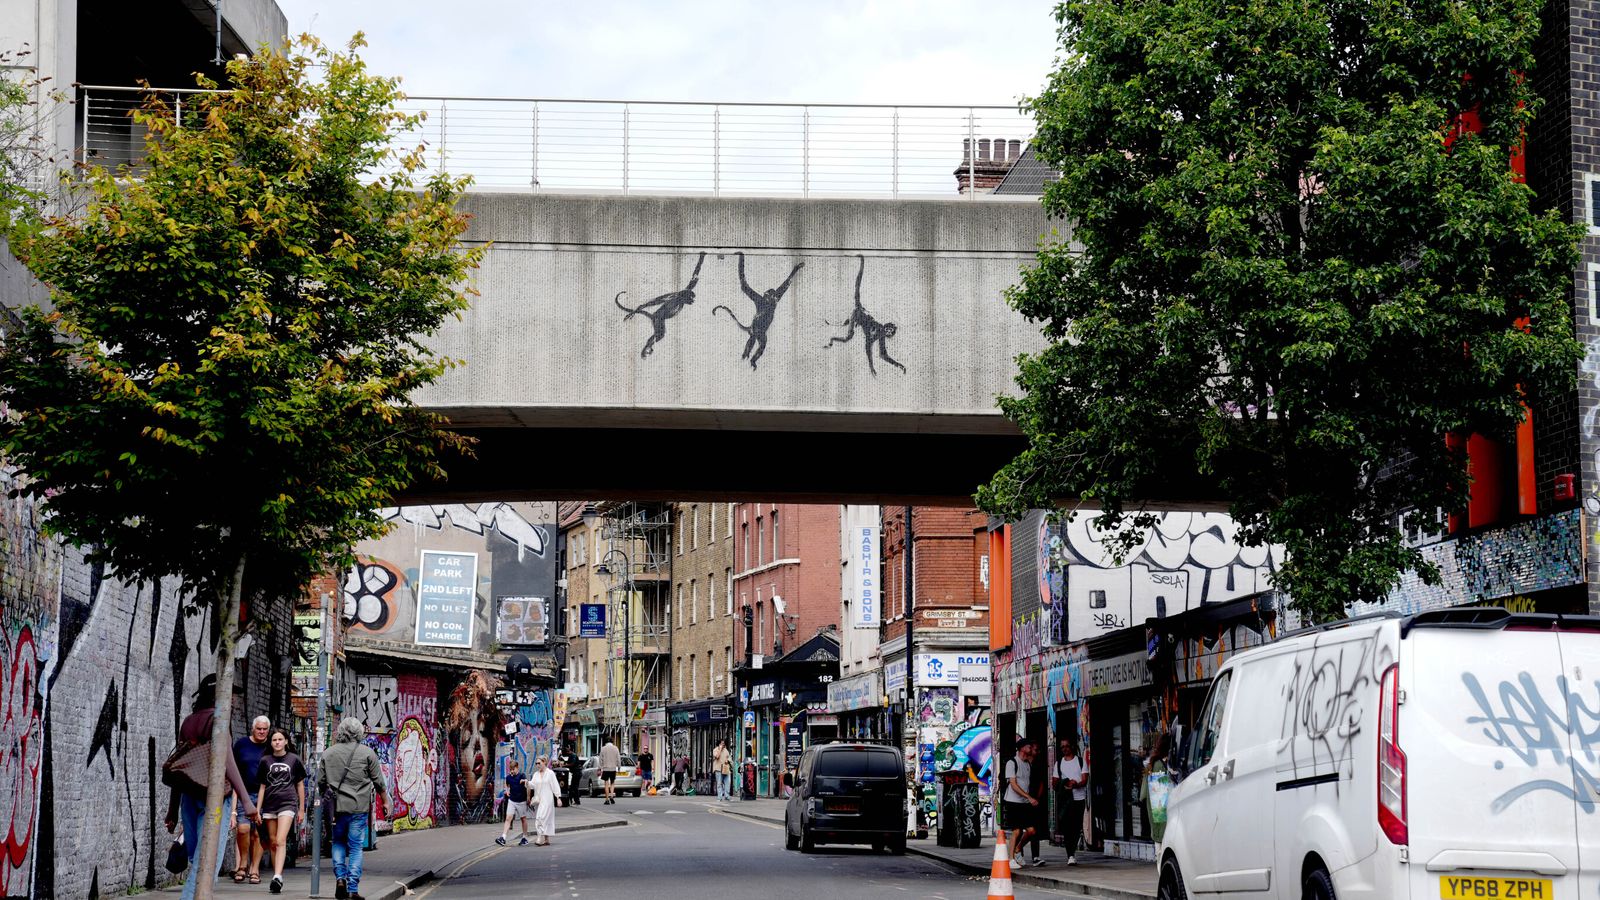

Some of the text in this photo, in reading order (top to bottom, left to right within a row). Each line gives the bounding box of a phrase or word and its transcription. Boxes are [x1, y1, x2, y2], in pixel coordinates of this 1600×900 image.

[438, 557, 461, 567] CAR
[433, 568, 463, 578] PARK
[862, 528, 872, 622] BASHIR & SONS
[422, 584, 473, 595] 2ND LEFT
[441, 604, 468, 614] ULEZ
[424, 621, 440, 629] NO
[425, 632, 463, 641] CHARGE
[818, 675, 833, 683] 182
[1098, 664, 1122, 686] FUTURE
[1448, 878, 1543, 899] YP68 ZPH
